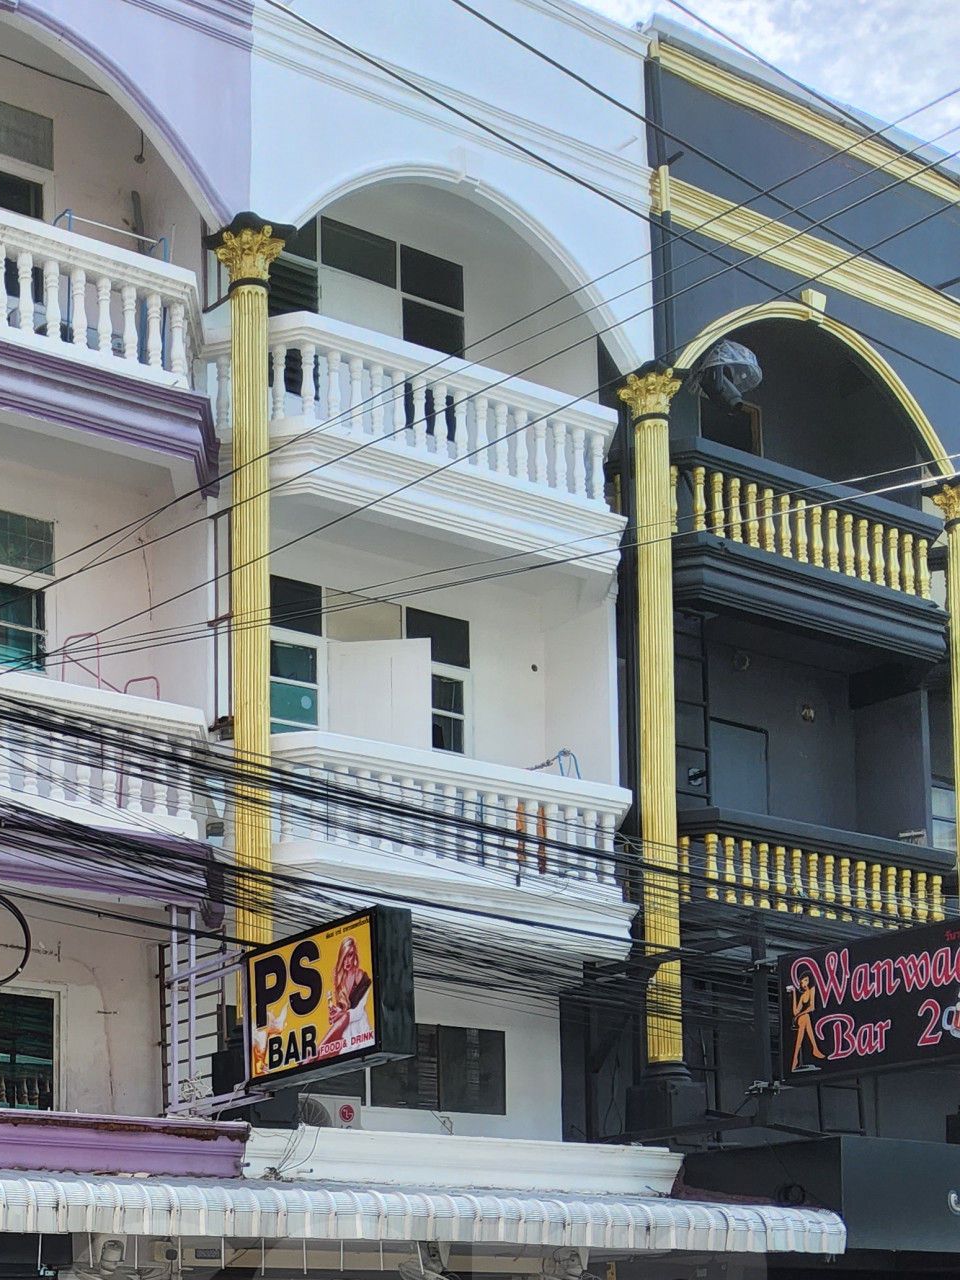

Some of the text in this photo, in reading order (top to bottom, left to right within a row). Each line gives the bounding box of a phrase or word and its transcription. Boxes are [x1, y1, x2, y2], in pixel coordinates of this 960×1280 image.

[254, 940, 323, 1029] PS
[791, 948, 960, 1008] Wanwa
[268, 1025, 317, 1070] BAR
[320, 1041, 341, 1056] FOOD
[350, 1030, 374, 1044] DRINK
[815, 1013, 891, 1060] Bar
